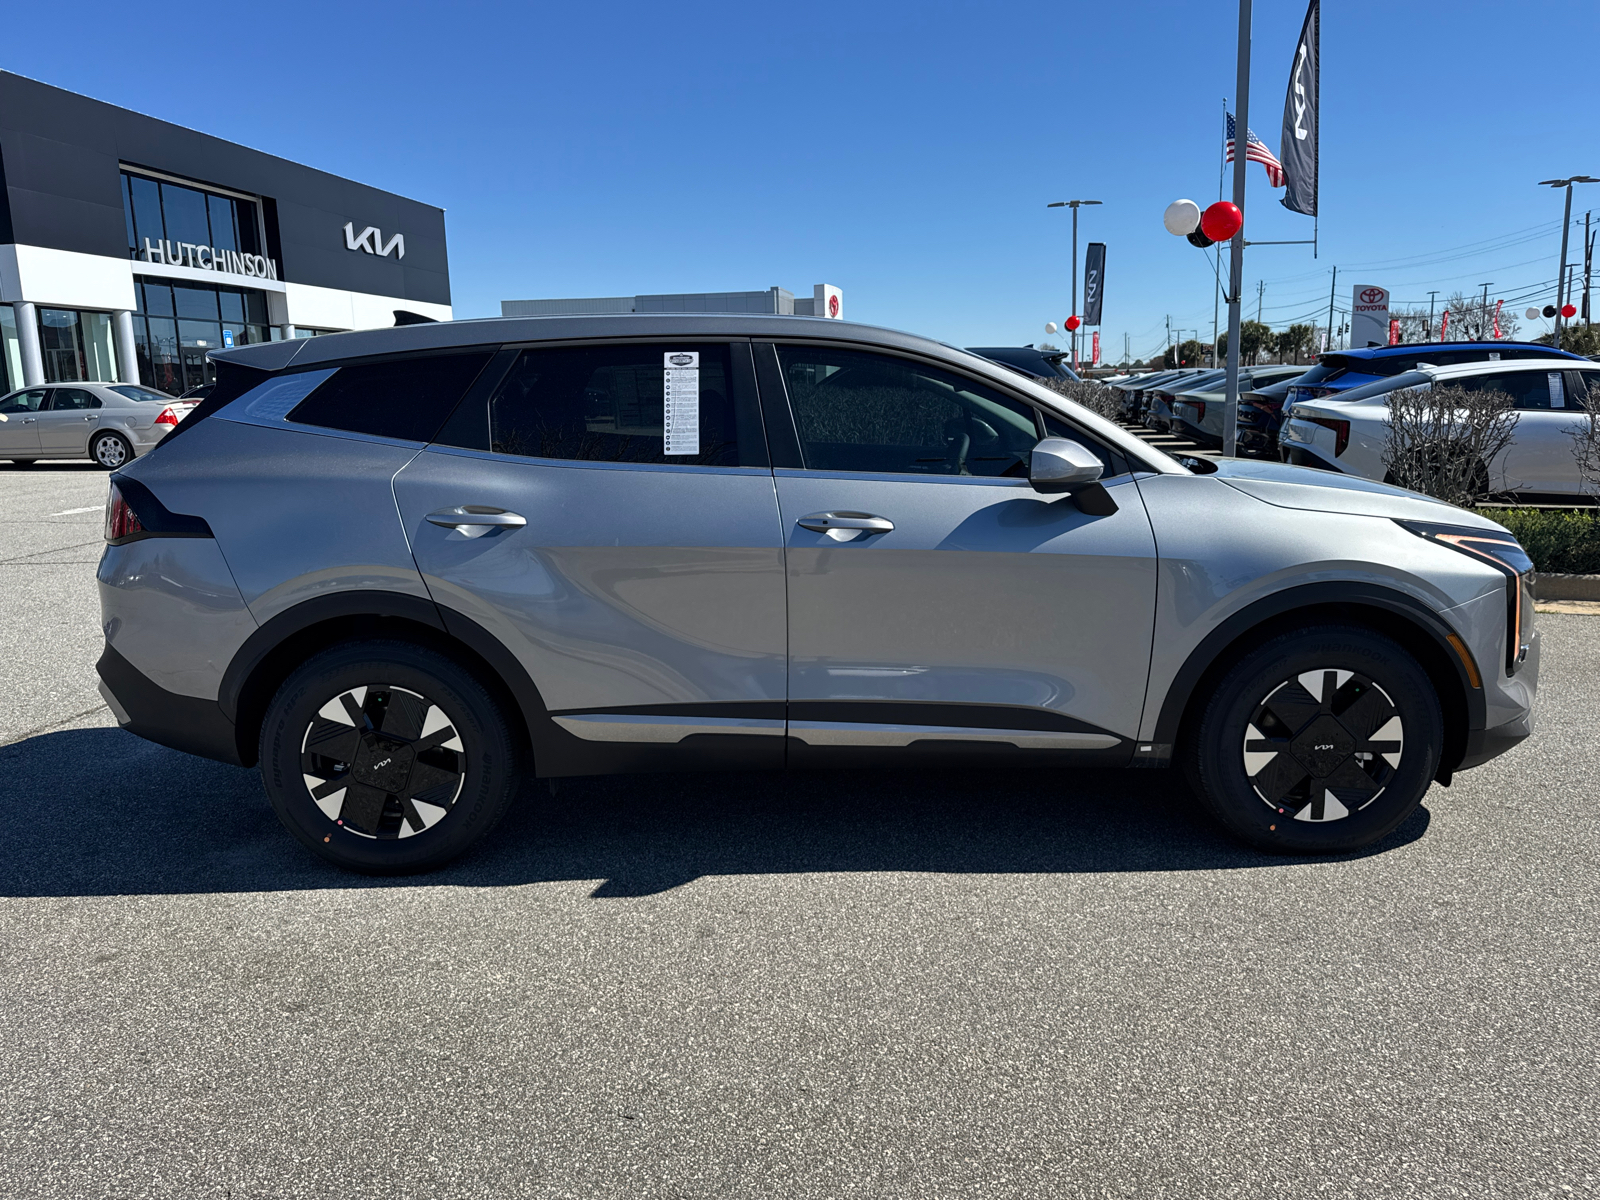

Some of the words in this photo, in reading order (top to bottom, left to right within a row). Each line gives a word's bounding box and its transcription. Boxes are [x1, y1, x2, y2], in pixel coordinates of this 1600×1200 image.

[143, 237, 277, 281] HUTCHINSON
[342, 221, 405, 260] KIA
[271, 718, 289, 788] Dynapro
[283, 686, 306, 716] HP2
